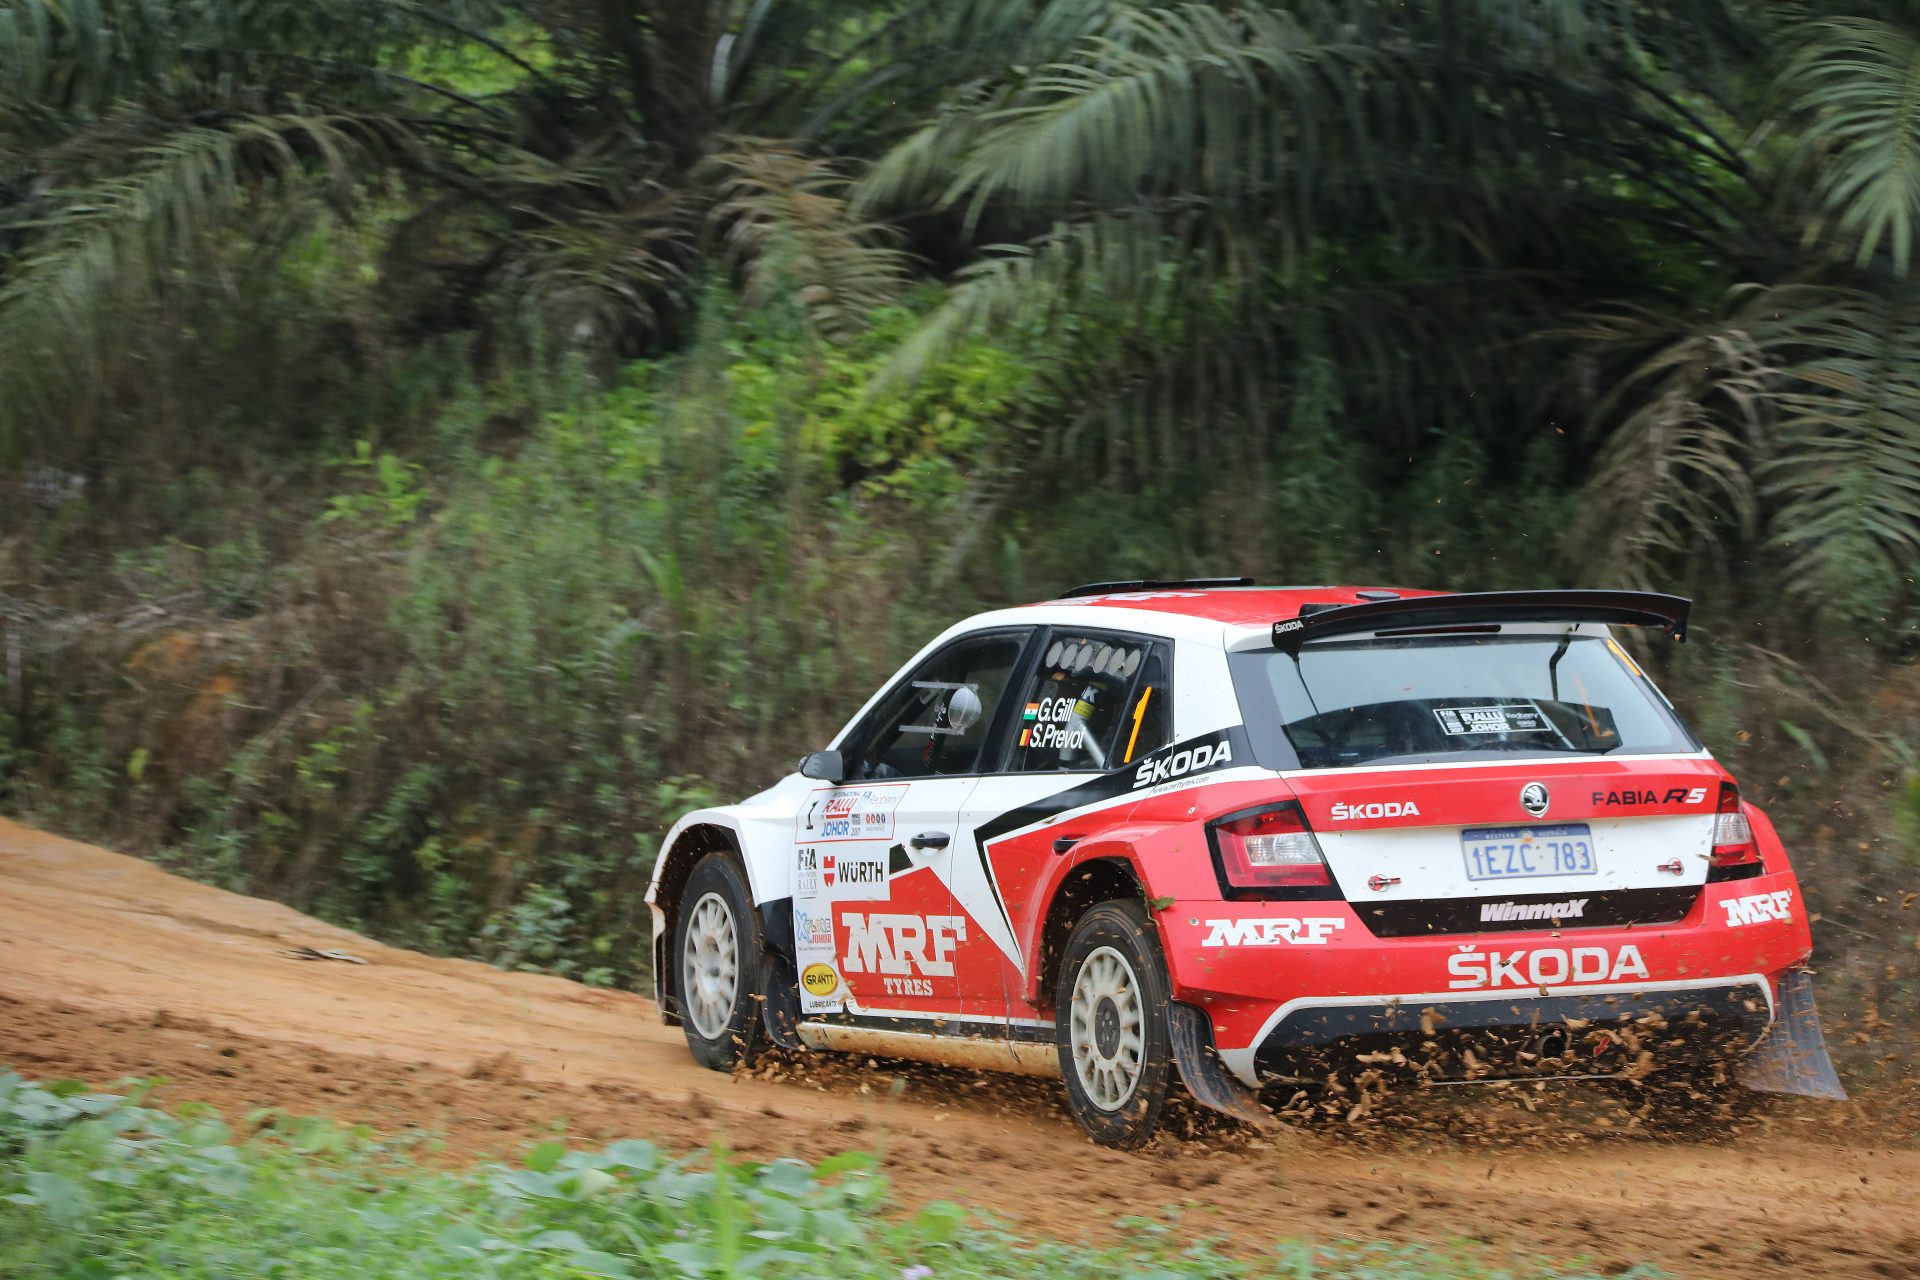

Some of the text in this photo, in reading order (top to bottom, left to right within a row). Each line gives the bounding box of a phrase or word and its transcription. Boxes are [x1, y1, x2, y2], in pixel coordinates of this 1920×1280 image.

[1275, 619, 1304, 634] ŠKODA
[1037, 696, 1077, 722] G.Gill
[1470, 722, 1512, 733] JOHOR
[1132, 740, 1233, 789] ŠKODA
[823, 798, 859, 813] RALLY
[1591, 787, 1707, 806] FABIA R5
[805, 800, 819, 830] 1
[1330, 801, 1421, 821] ŠKODA
[821, 821, 850, 837] JOHOR
[1484, 831, 1515, 840] WESTERN
[1472, 841, 1592, 876] 1EZC 783
[838, 860, 884, 883] WÜRTH
[1718, 887, 1793, 928] MRF
[810, 933, 832, 944] JOHOR
[1202, 917, 1345, 947] MRF
[841, 912, 967, 977] MRF
[1447, 944, 1650, 989] ŠKODA
[806, 974, 834, 985] GRANTT
[883, 977, 934, 997] TYRES
[809, 1000, 837, 1008] LUBRICANTS
